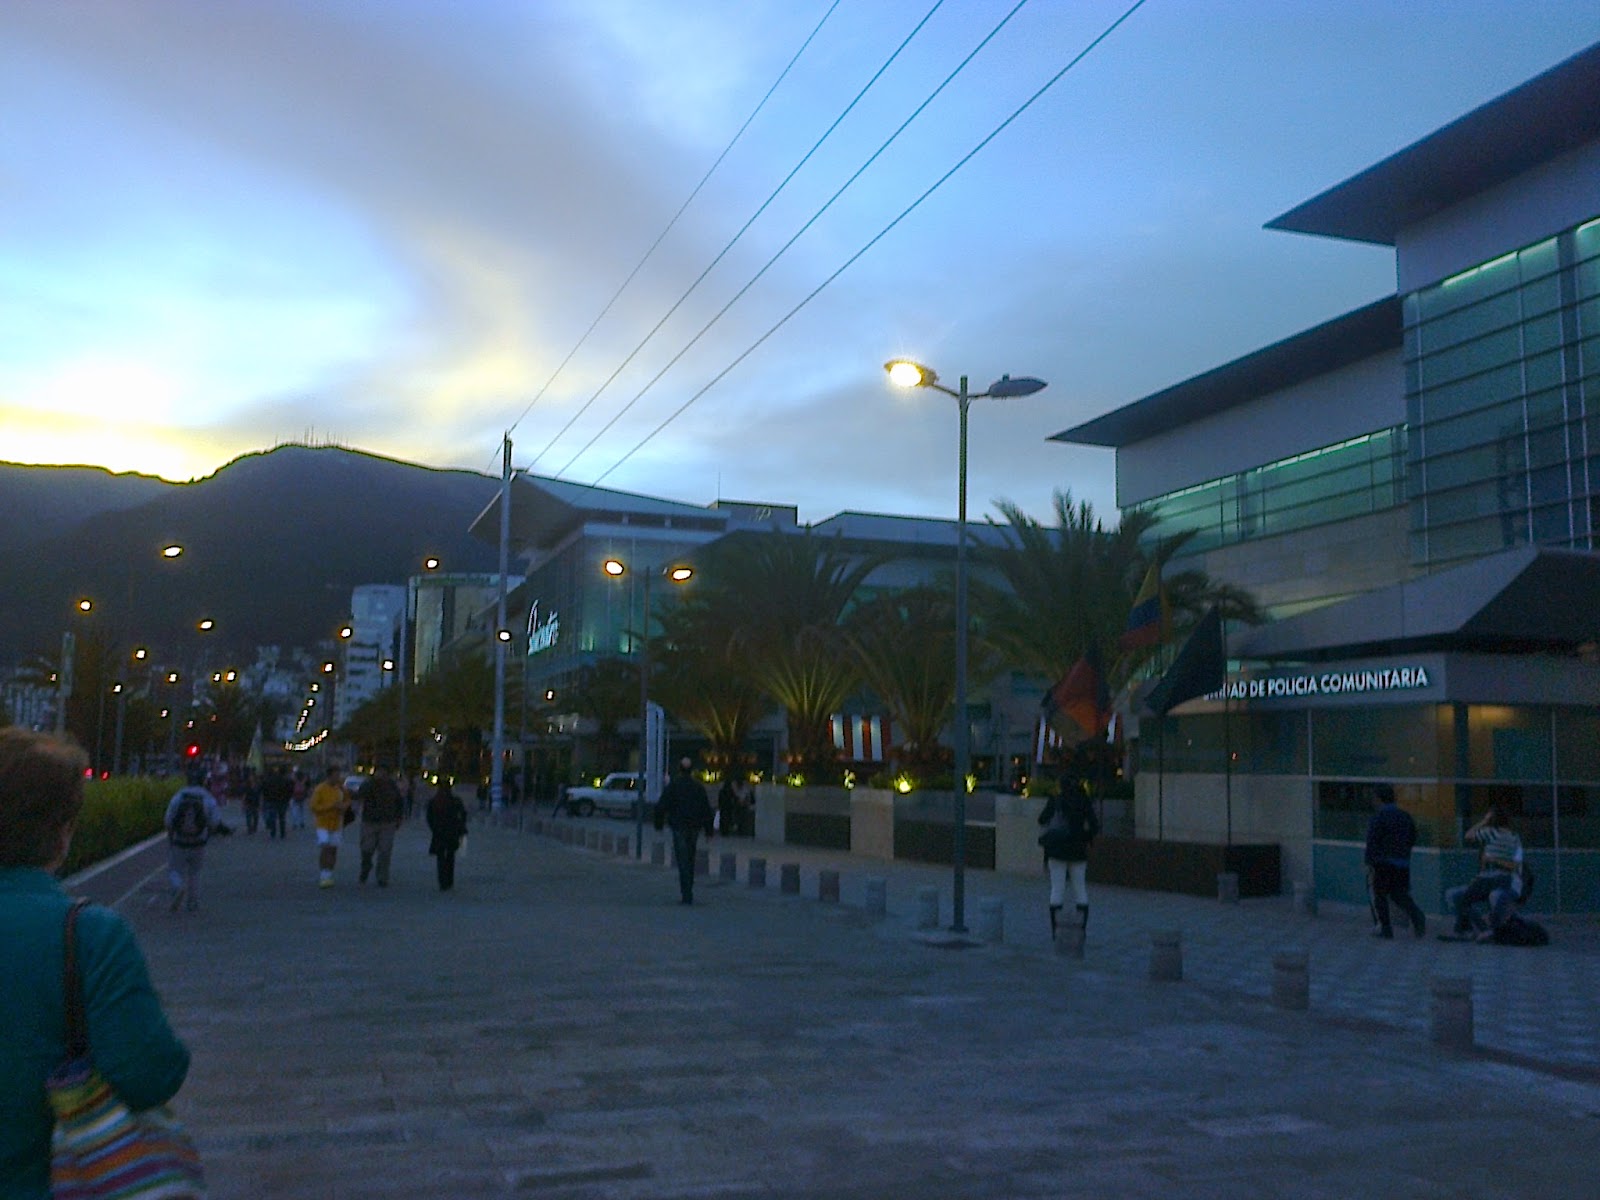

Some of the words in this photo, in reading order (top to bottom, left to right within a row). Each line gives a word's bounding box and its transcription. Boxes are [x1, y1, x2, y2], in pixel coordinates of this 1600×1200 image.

[1250, 678, 1266, 698] DE
[1268, 675, 1318, 697] POLICIA
[1320, 665, 1429, 693] COMUNITARIA
